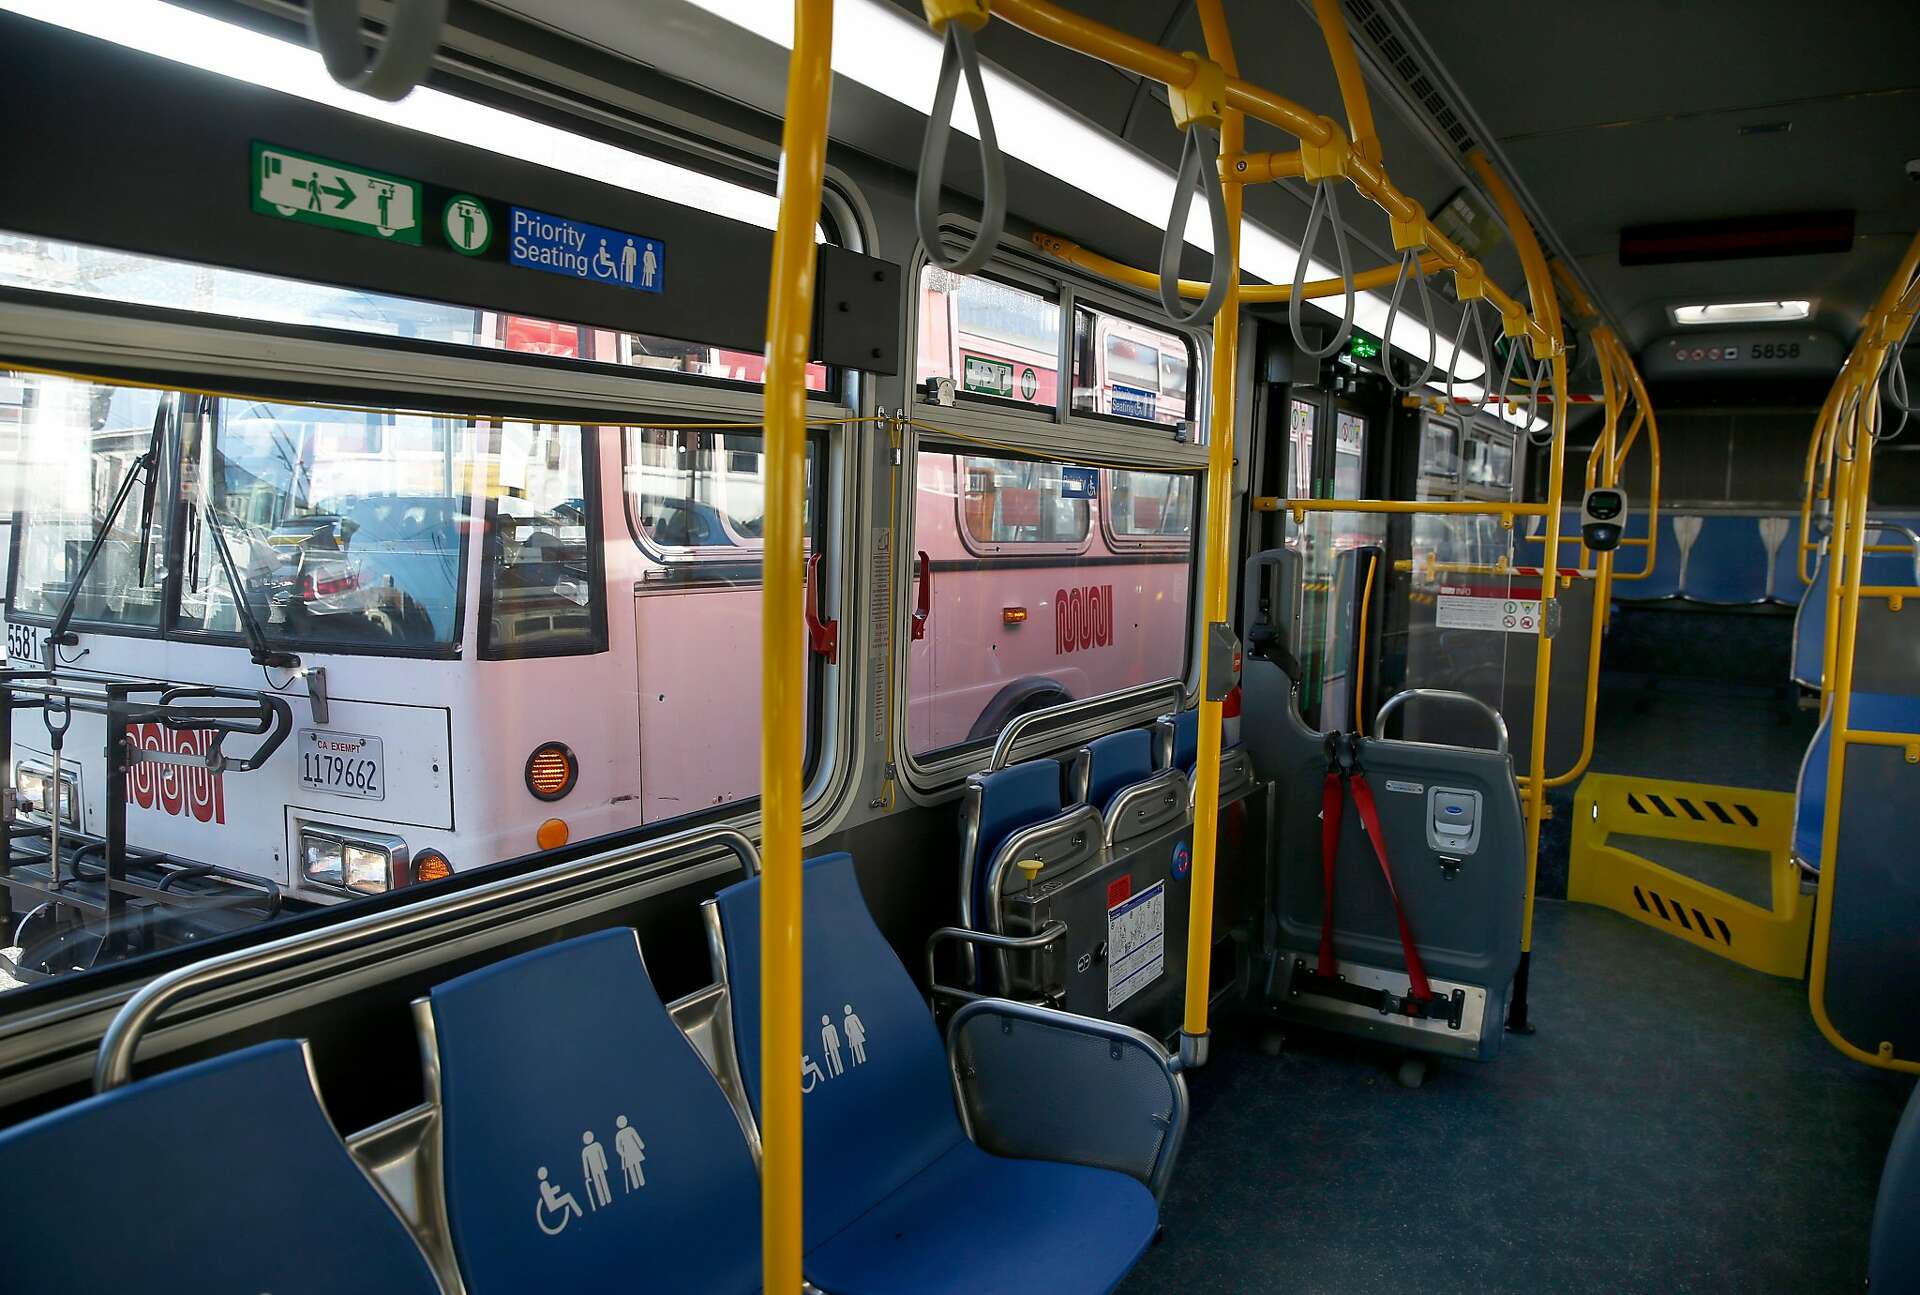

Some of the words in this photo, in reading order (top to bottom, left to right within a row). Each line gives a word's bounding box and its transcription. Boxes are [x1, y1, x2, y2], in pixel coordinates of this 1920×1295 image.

[514, 211, 586, 251] Priority
[513, 236, 589, 276] Seating
[1751, 344, 1800, 359] 5858
[8, 624, 37, 660] 5581
[317, 740, 328, 750] CA
[331, 742, 360, 753] EXEMPT
[303, 752, 377, 791] 1179662
